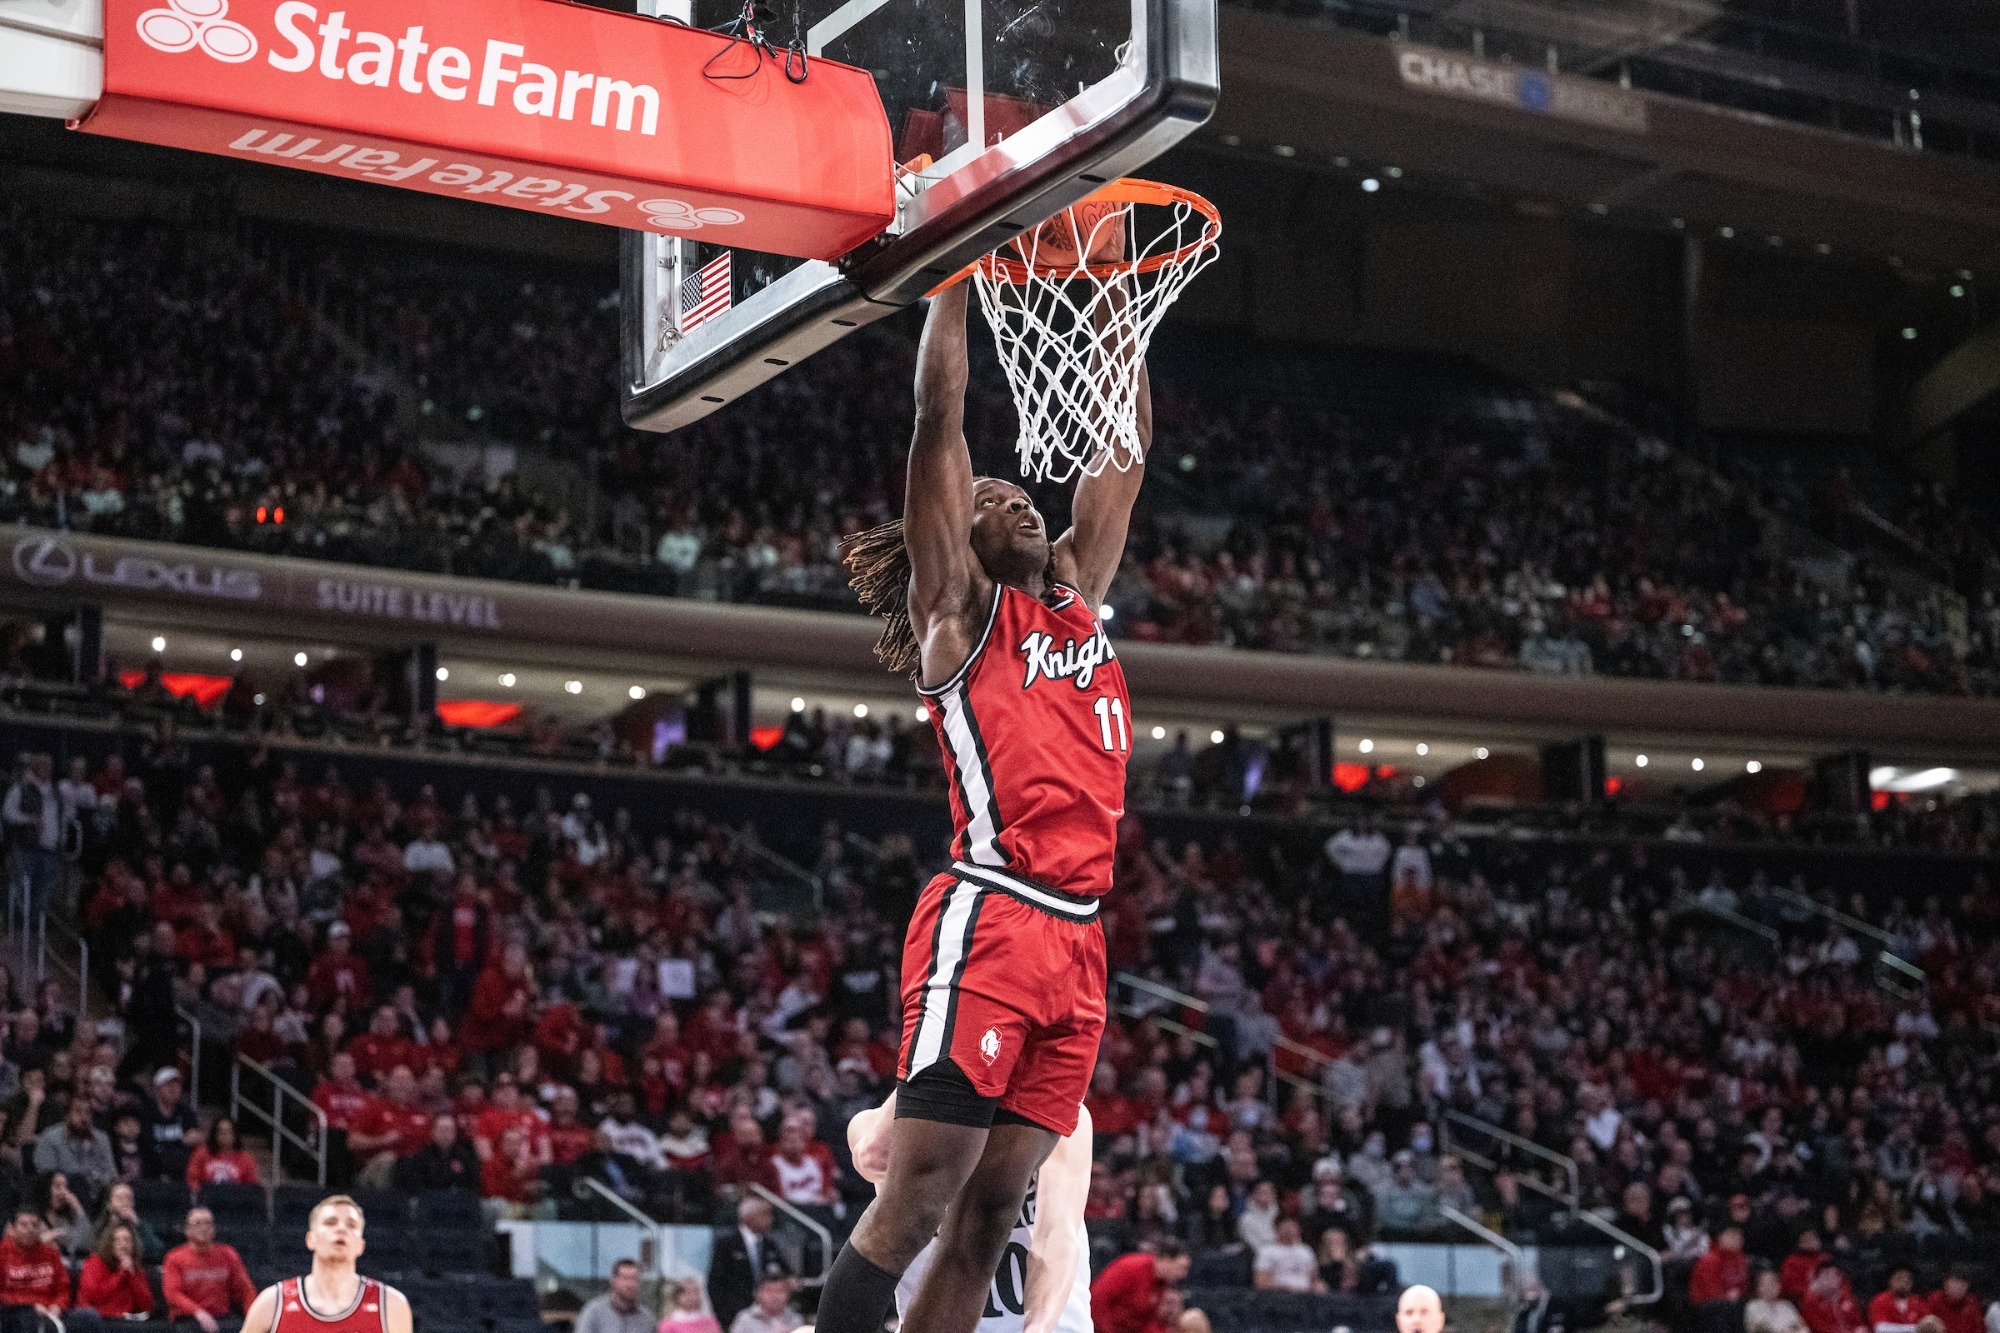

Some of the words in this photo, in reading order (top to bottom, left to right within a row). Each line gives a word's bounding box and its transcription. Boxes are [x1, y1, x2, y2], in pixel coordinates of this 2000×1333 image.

[316, 577, 403, 619] SUITE
[411, 588, 502, 631] LEVEL
[1093, 696, 1127, 752] 11
